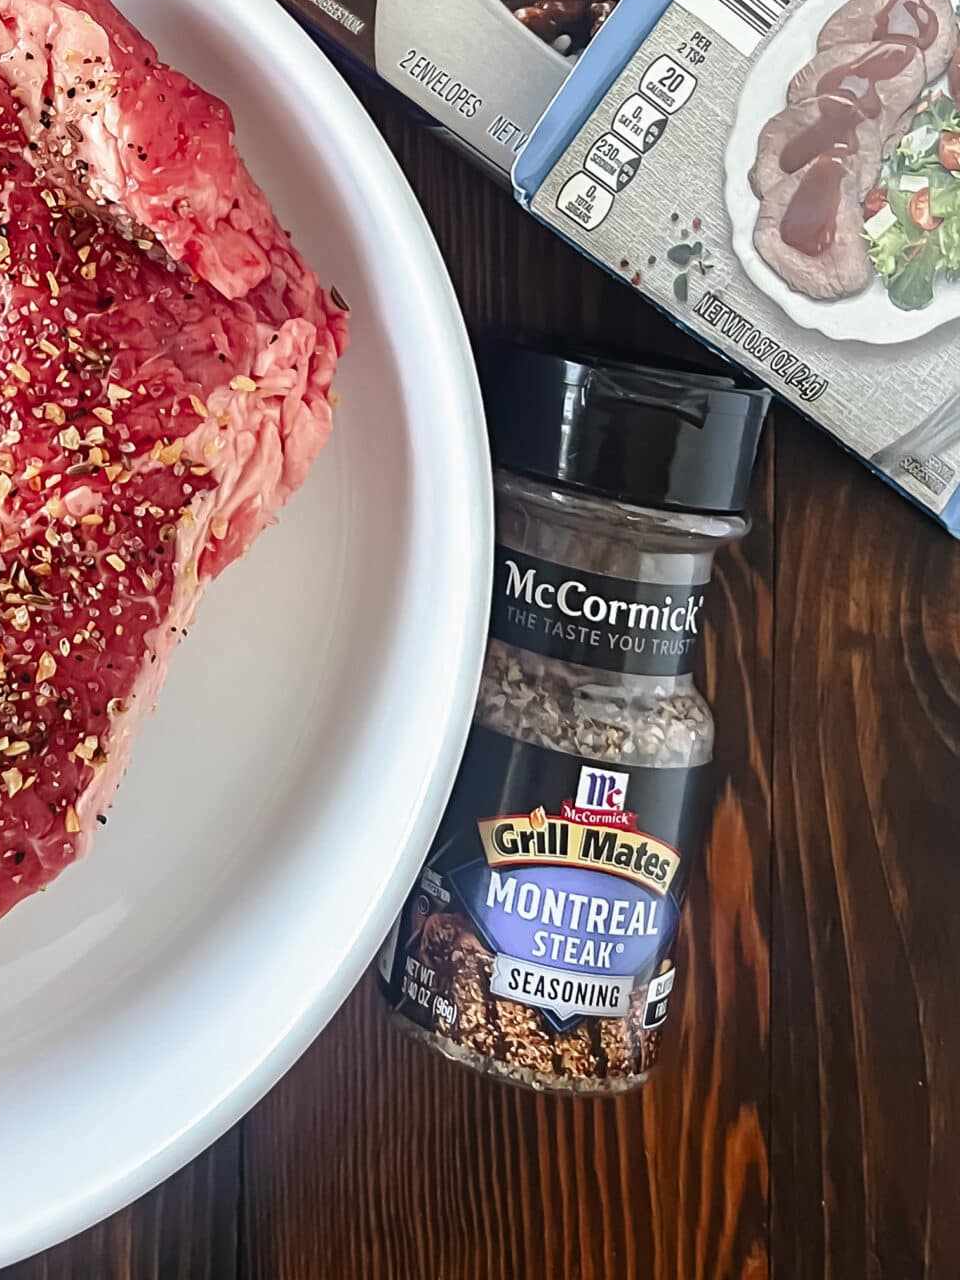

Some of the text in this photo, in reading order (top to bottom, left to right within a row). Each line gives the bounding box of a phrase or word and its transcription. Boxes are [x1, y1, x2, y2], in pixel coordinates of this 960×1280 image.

[676, 42, 706, 66] 2 TSP
[689, 31, 712, 53] PER
[399, 49, 417, 69] 2
[408, 56, 483, 118] ENVELOPES
[487, 115, 521, 145] NET
[658, 66, 685, 93] 20
[693, 291, 829, 402] NET WT 0.87 OZ (24g)
[505, 560, 699, 634] McCormick
[506, 605, 691, 656] THE TASTE YOU TRUST
[563, 804, 630, 825] McCormick
[492, 823, 672, 882] Grill Mates
[486, 871, 659, 937] MONTREAL
[531, 930, 613, 969] STEAK
[421, 967, 436, 988] WT
[507, 967, 621, 1009] SEASONING
[417, 988, 431, 1008] OZ
[432, 995, 458, 1025] (96g)
